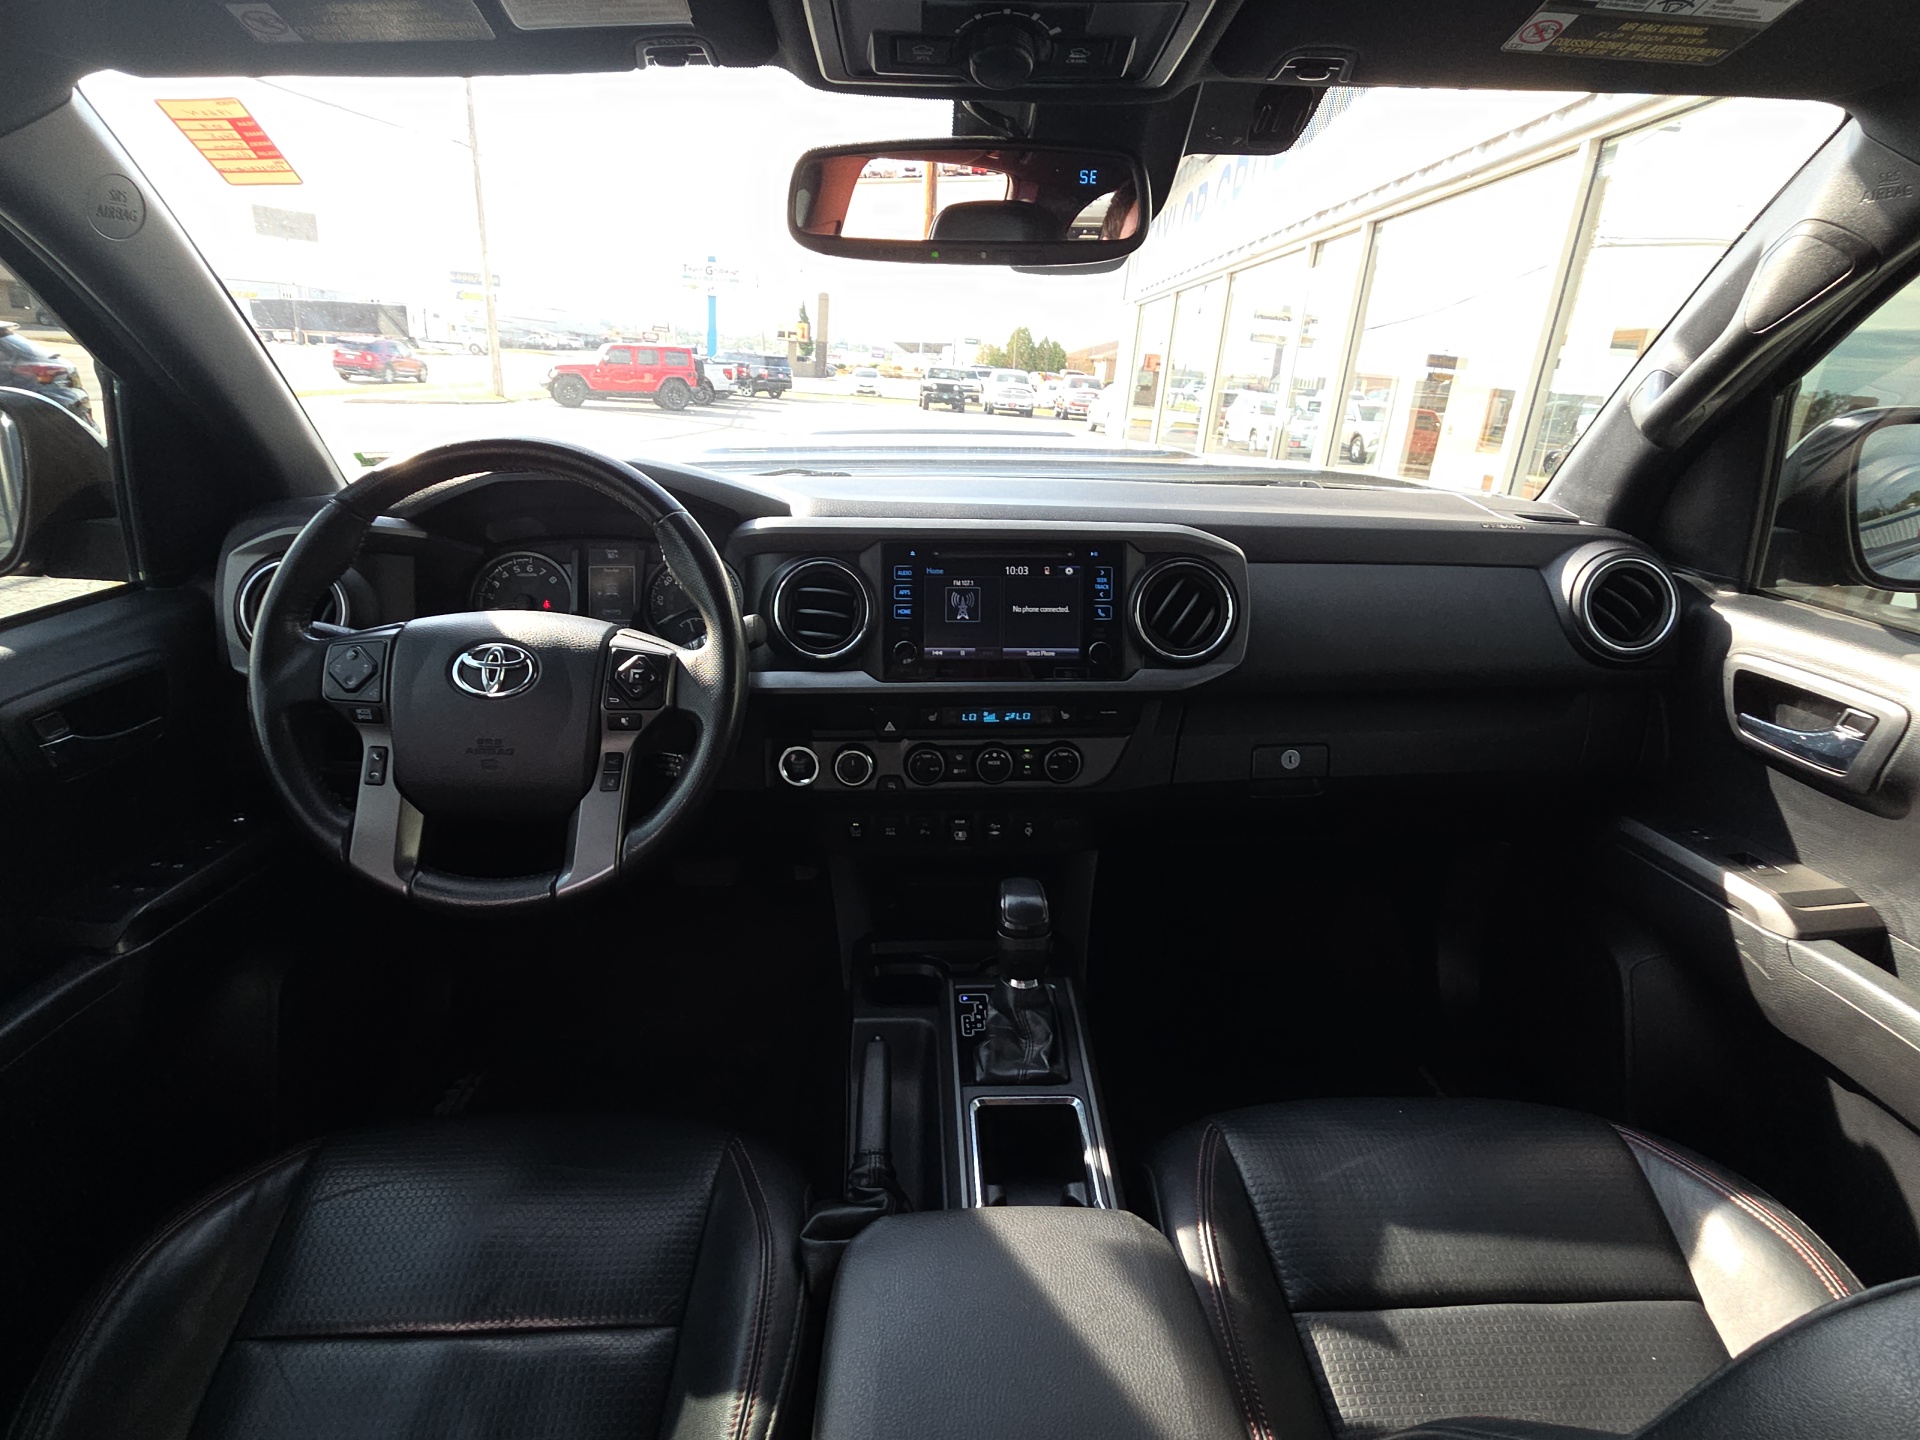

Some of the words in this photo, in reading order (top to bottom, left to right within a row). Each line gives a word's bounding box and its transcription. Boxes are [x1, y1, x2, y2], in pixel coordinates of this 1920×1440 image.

[1618, 22, 1638, 32] AIR
[1636, 23, 1661, 33] BAG
[1660, 25, 1709, 36] WARNING
[1079, 170, 1098, 185] SE
[95, 204, 138, 223] AIRBAG
[926, 567, 944, 575] Home
[1005, 566, 1029, 576] 10:03
[1022, 606, 1039, 614] phone
